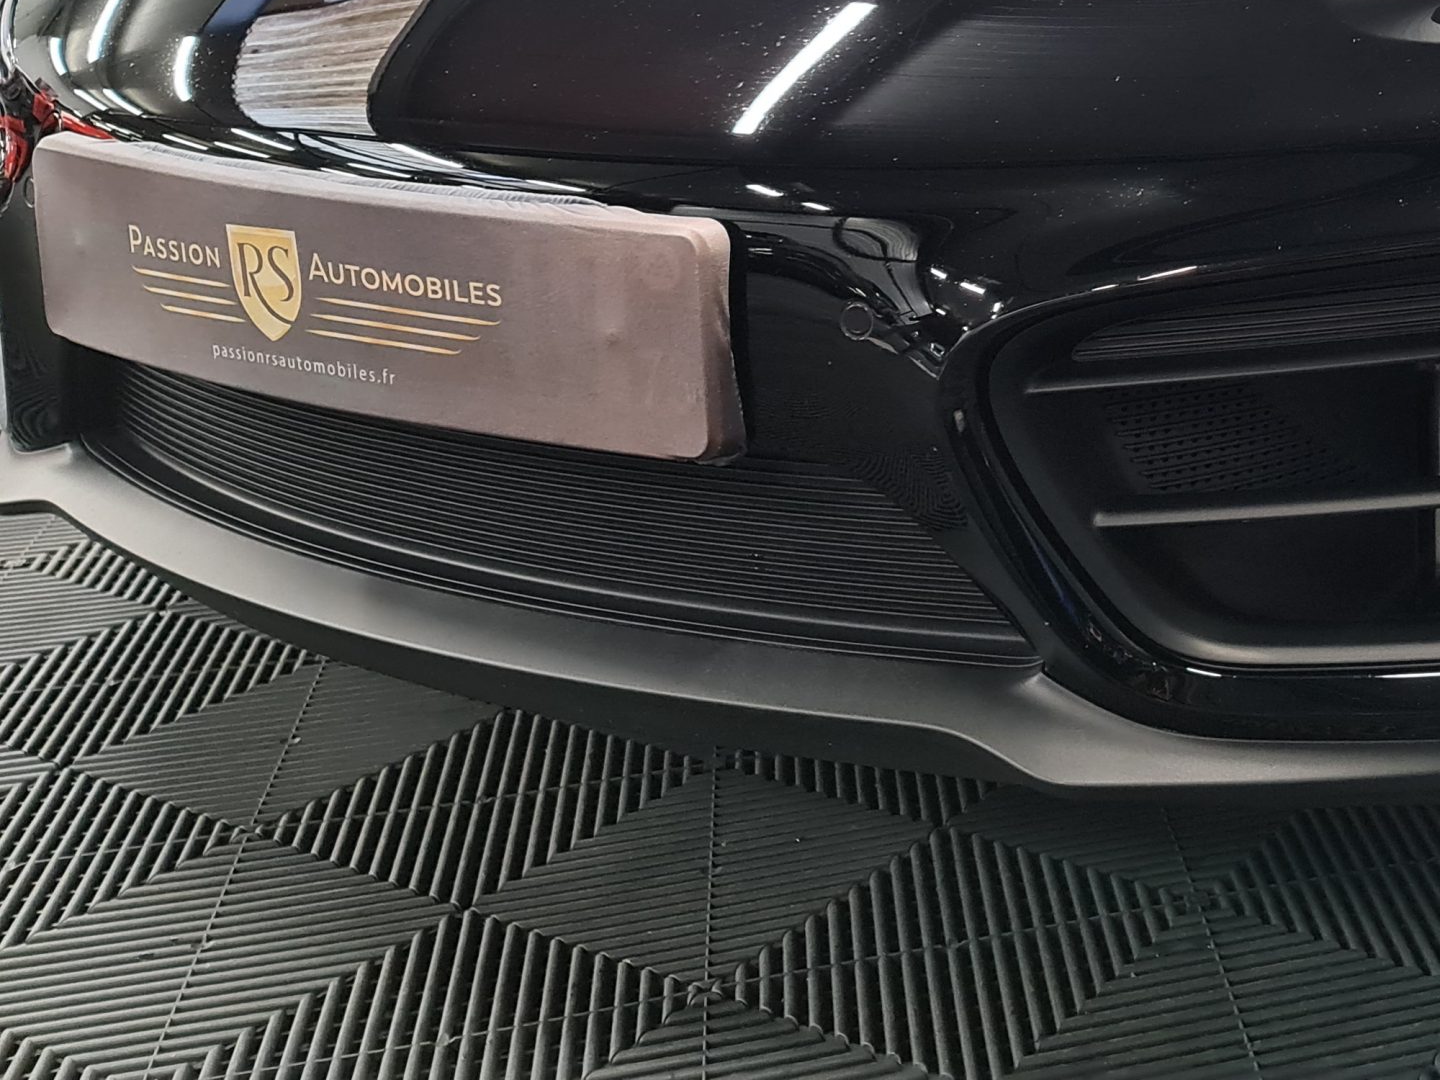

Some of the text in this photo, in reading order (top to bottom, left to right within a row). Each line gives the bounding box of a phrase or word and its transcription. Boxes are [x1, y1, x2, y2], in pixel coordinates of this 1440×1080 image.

[128, 224, 503, 326] PASSION RS AUTOMOBILES
[212, 344, 396, 386] passionrsautomobiles.fr
